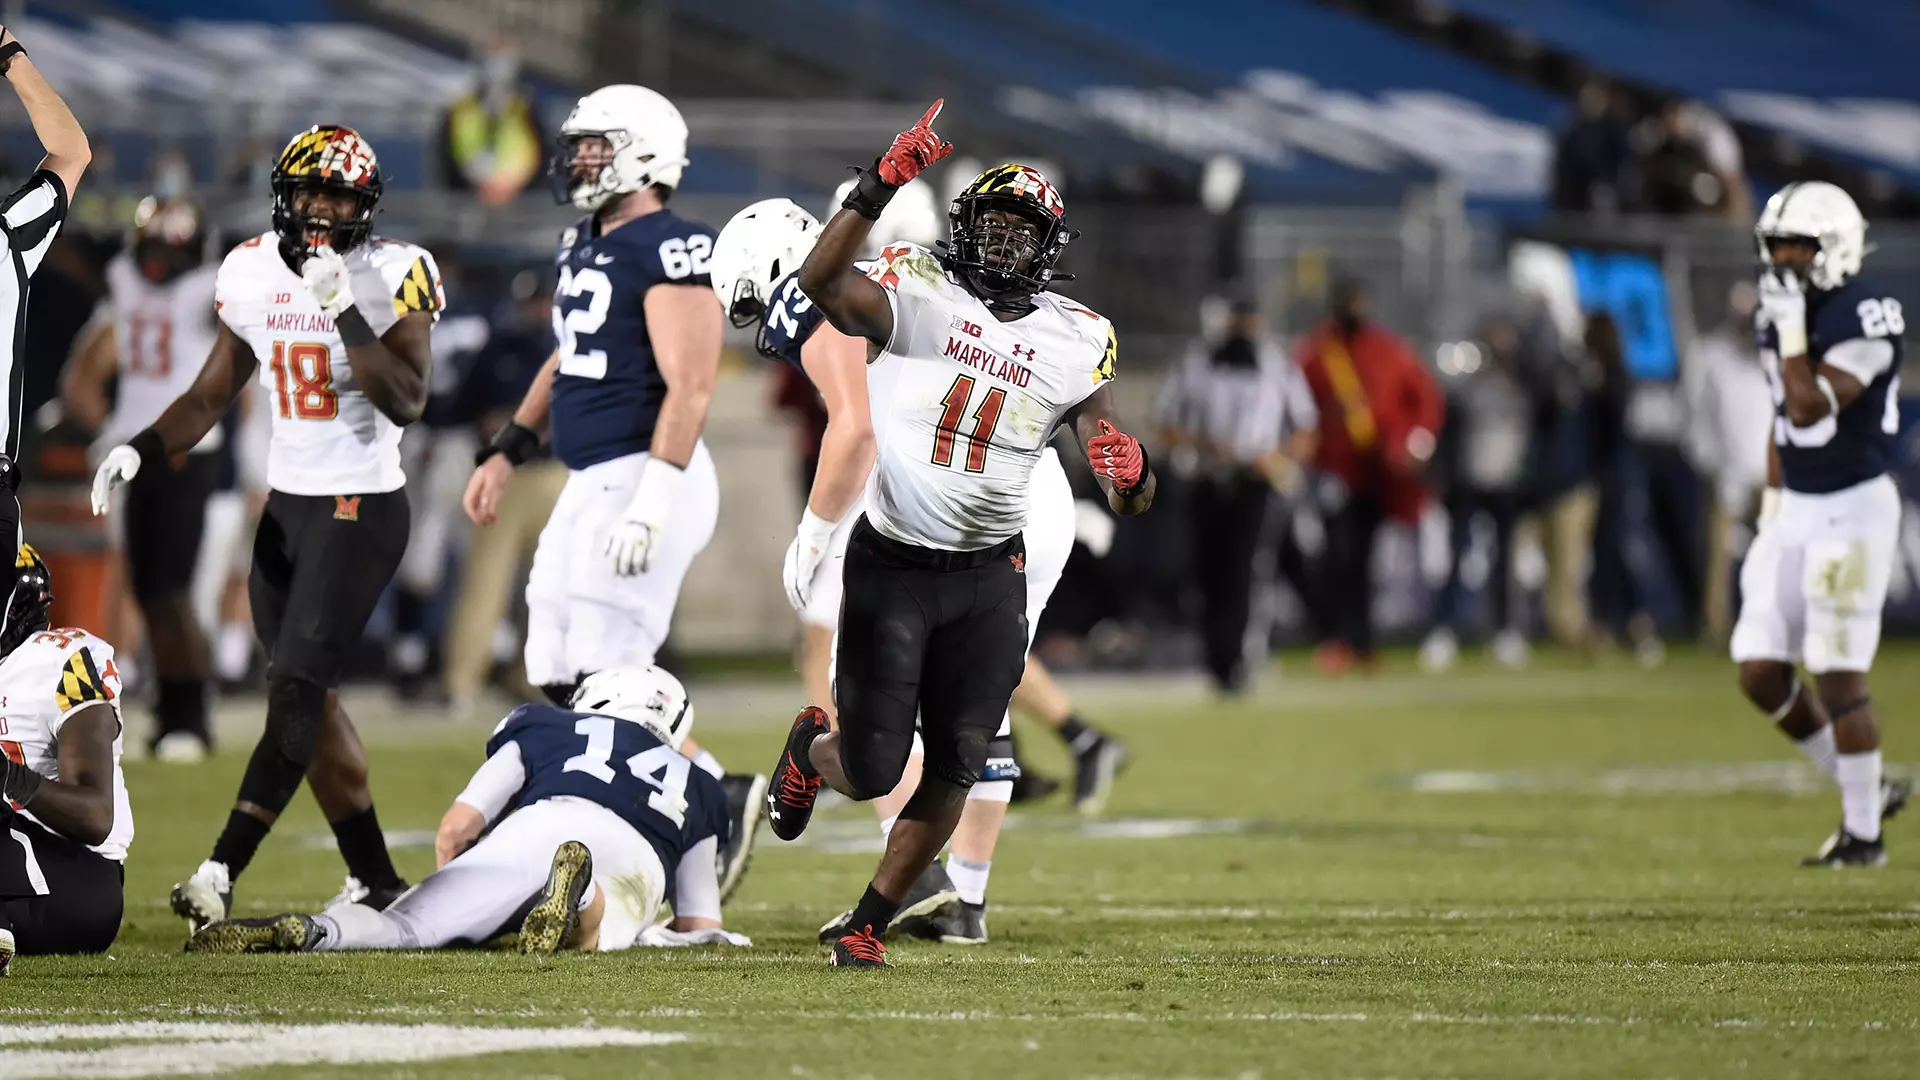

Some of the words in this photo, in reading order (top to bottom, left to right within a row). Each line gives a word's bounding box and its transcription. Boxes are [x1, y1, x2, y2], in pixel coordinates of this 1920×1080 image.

[658, 234, 713, 279] 62
[266, 312, 336, 333] MARYLAND
[767, 277, 813, 339] 73
[950, 315, 983, 338] BIG
[271, 340, 339, 419] 18
[944, 336, 1032, 389] MARYLAND
[931, 373, 1008, 474] 11
[562, 716, 692, 830] 14
